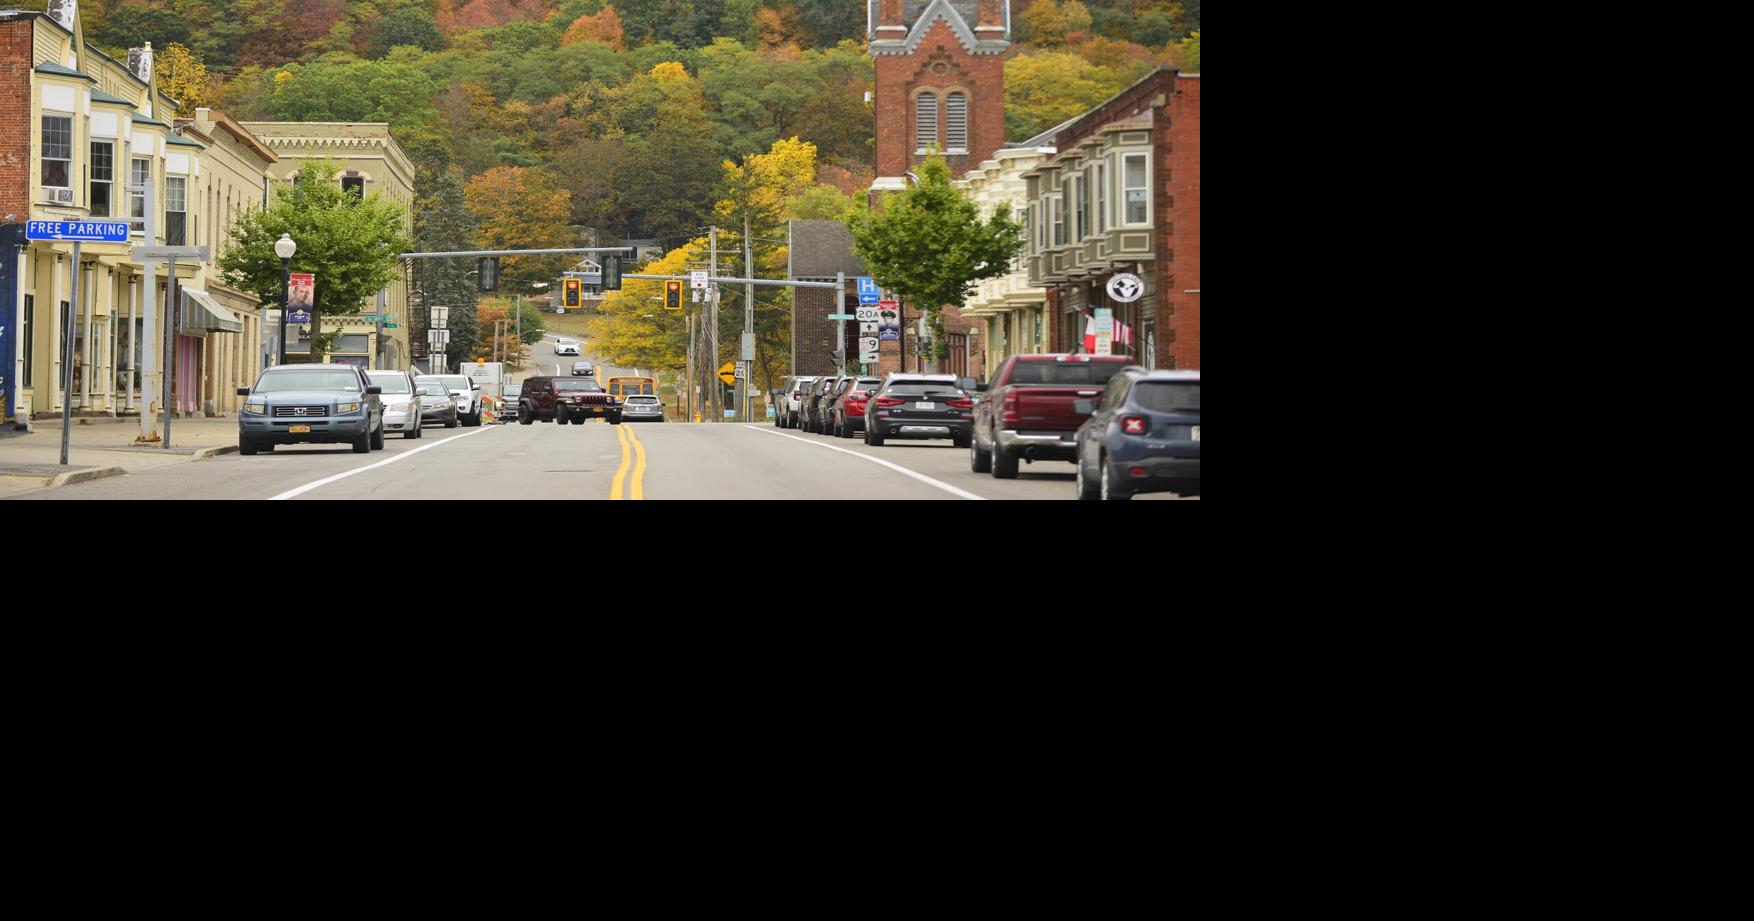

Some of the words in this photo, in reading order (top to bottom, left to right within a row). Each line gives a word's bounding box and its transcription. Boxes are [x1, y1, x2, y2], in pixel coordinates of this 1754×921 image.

[30, 221, 62, 234] FREE
[68, 223, 125, 236] PARKING
[862, 280, 875, 292] H
[858, 310, 879, 319] 20A
[868, 339, 877, 349] 9
